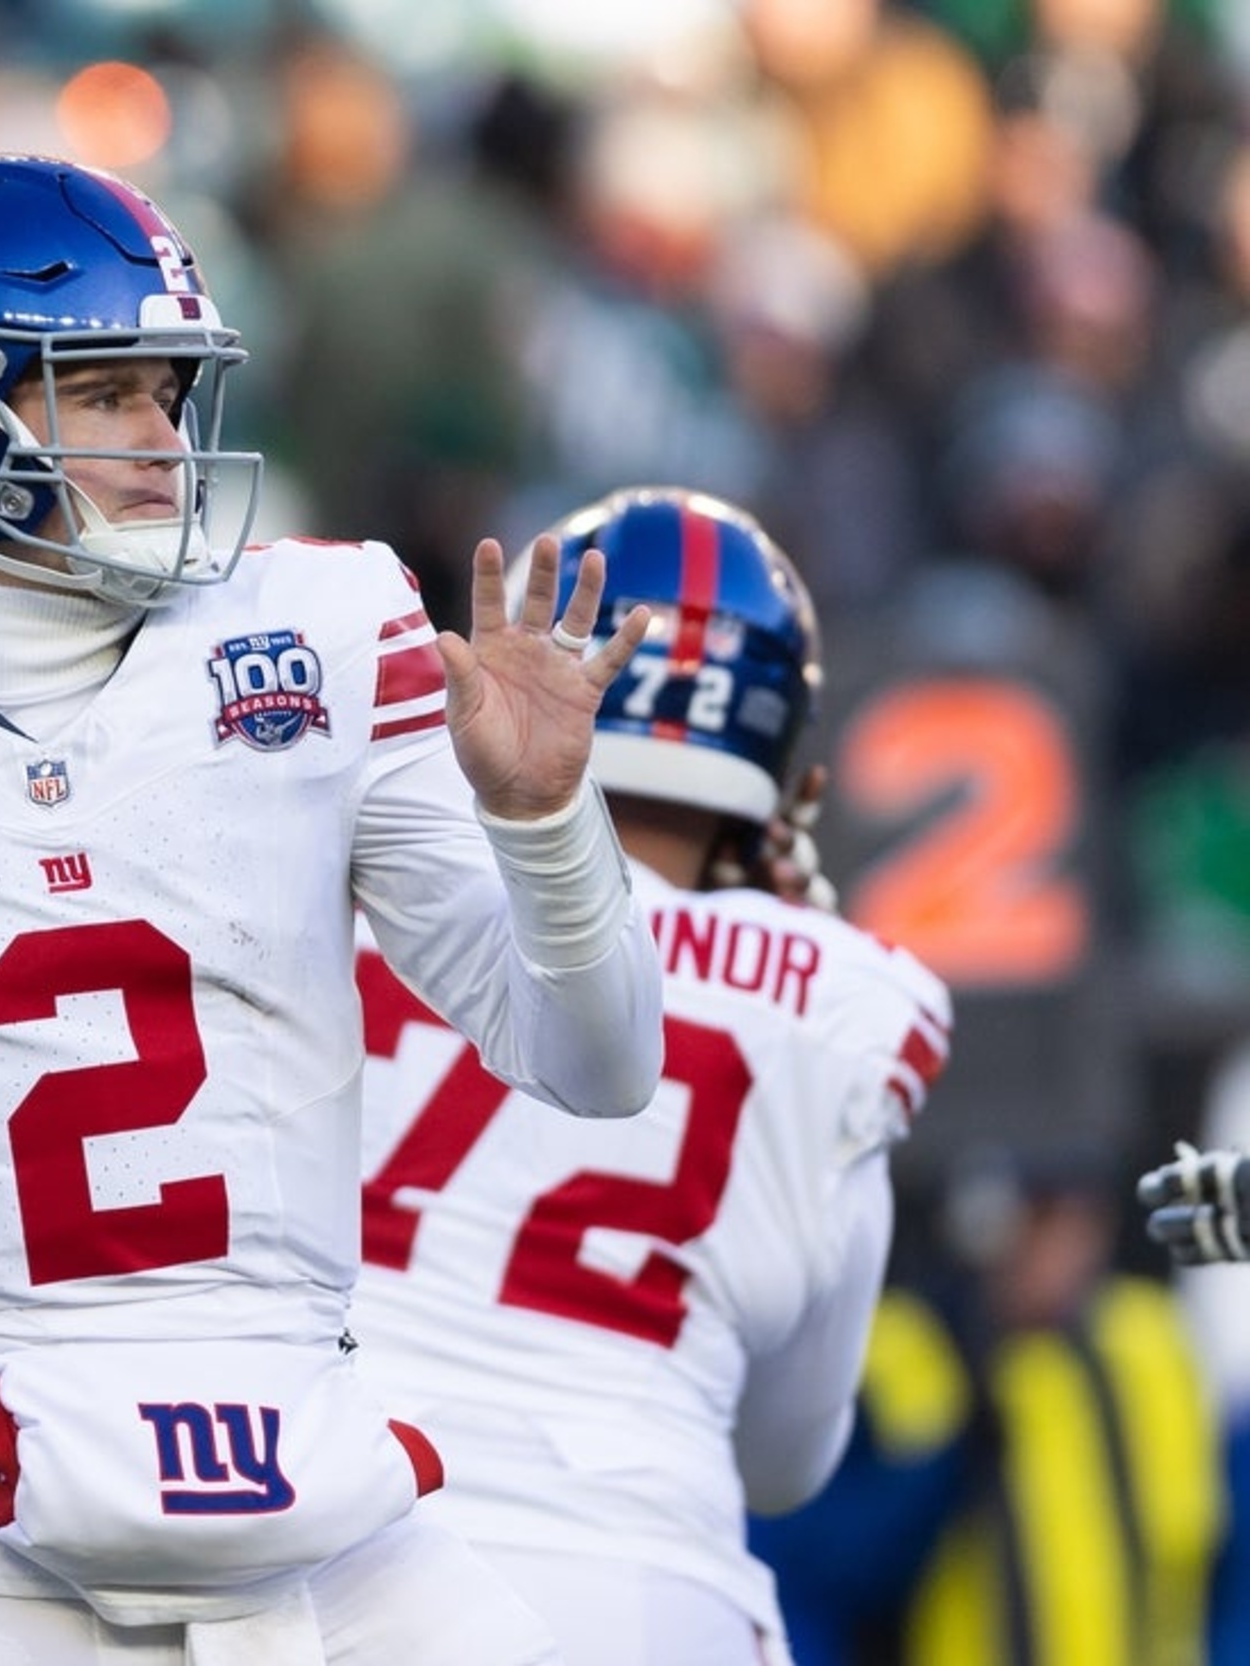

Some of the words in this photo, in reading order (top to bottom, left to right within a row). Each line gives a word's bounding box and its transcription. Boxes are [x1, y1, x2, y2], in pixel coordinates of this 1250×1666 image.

[150, 234, 191, 293] 2
[209, 646, 322, 708] 100
[229, 694, 313, 718] SEASONS
[622, 655, 734, 733] 72
[32, 777, 65, 800] NFL
[838, 675, 1095, 988] 2
[38, 851, 93, 894] ny
[354, 949, 754, 1351] 72
[136, 1401, 297, 1515] ny
